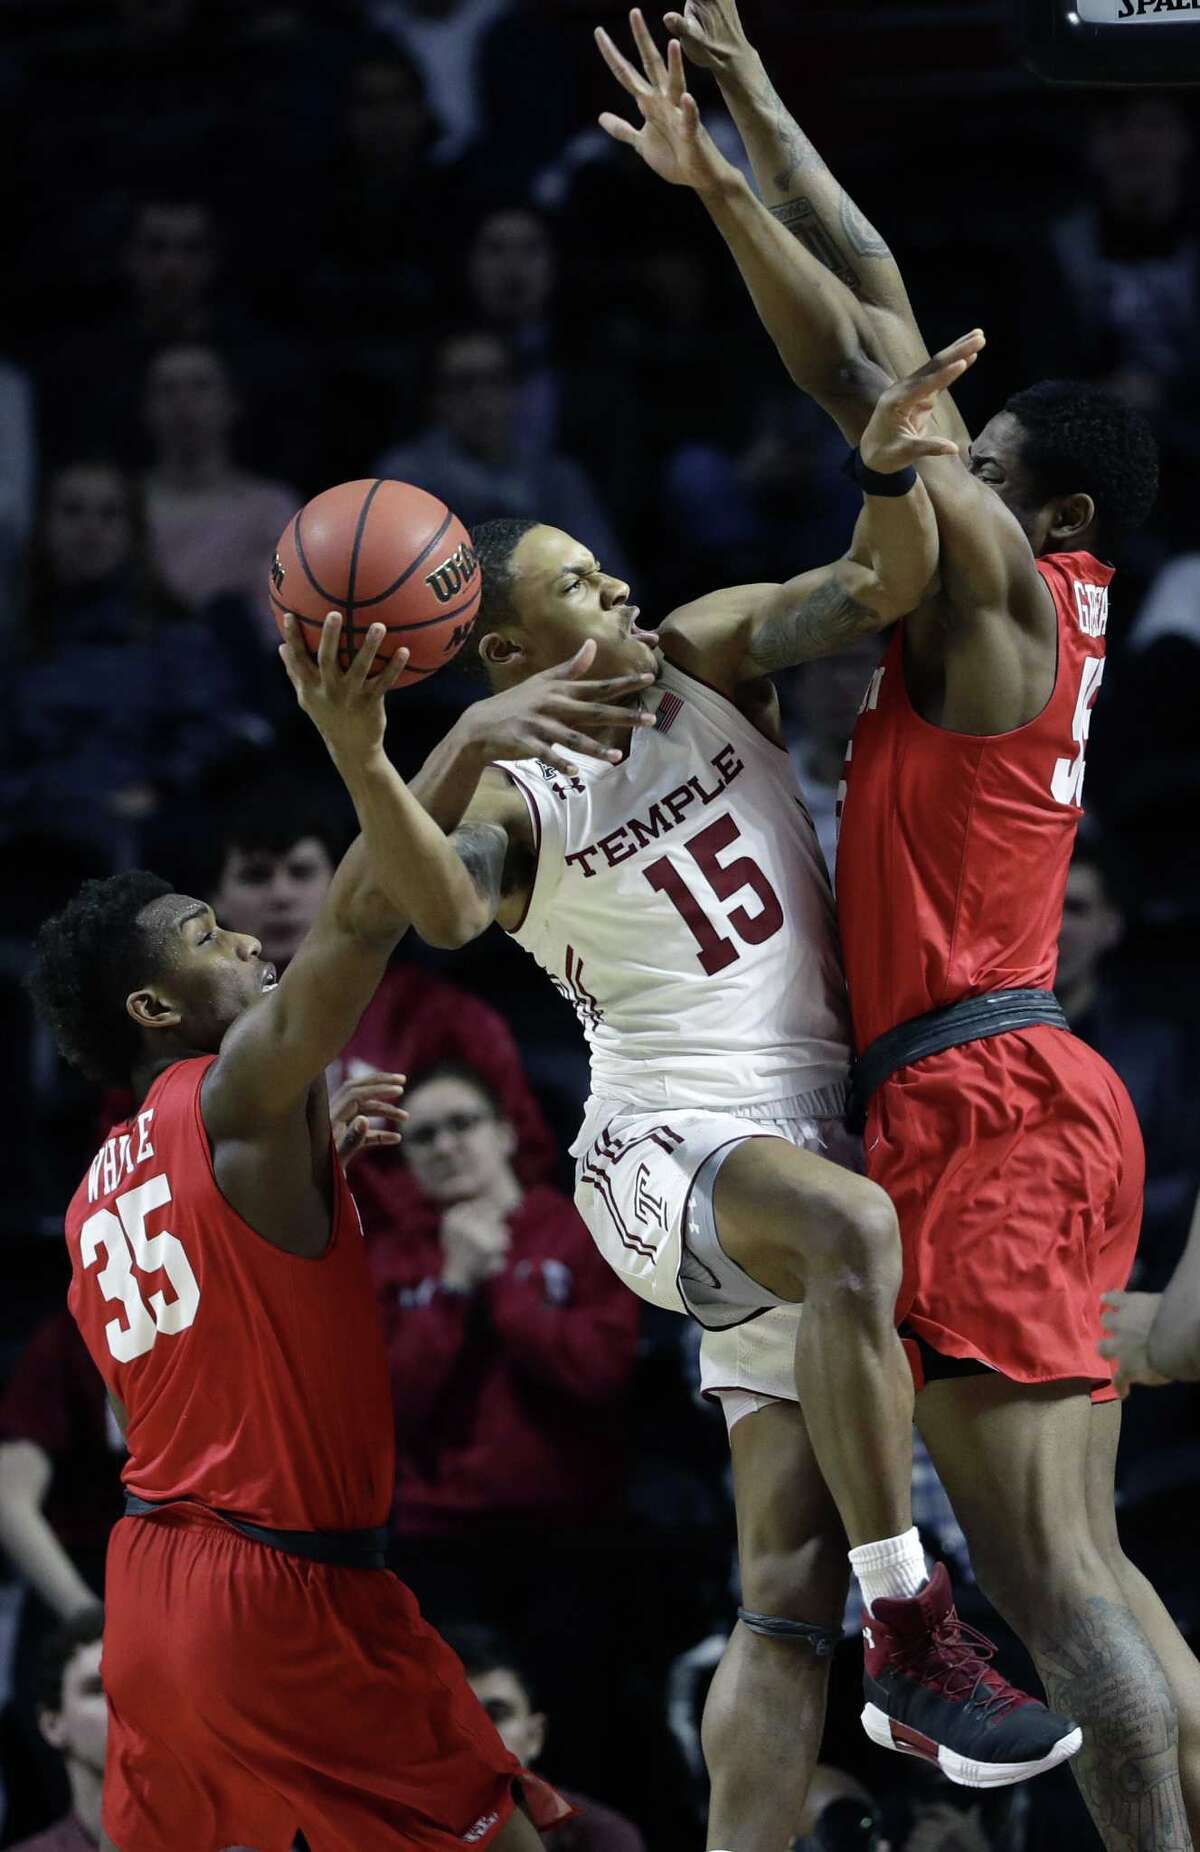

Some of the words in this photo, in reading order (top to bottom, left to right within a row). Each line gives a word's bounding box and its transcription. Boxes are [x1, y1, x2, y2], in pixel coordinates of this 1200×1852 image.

[565, 743, 745, 878] TEMPLE
[642, 812, 784, 977] 15
[80, 1173, 200, 1363] 35
